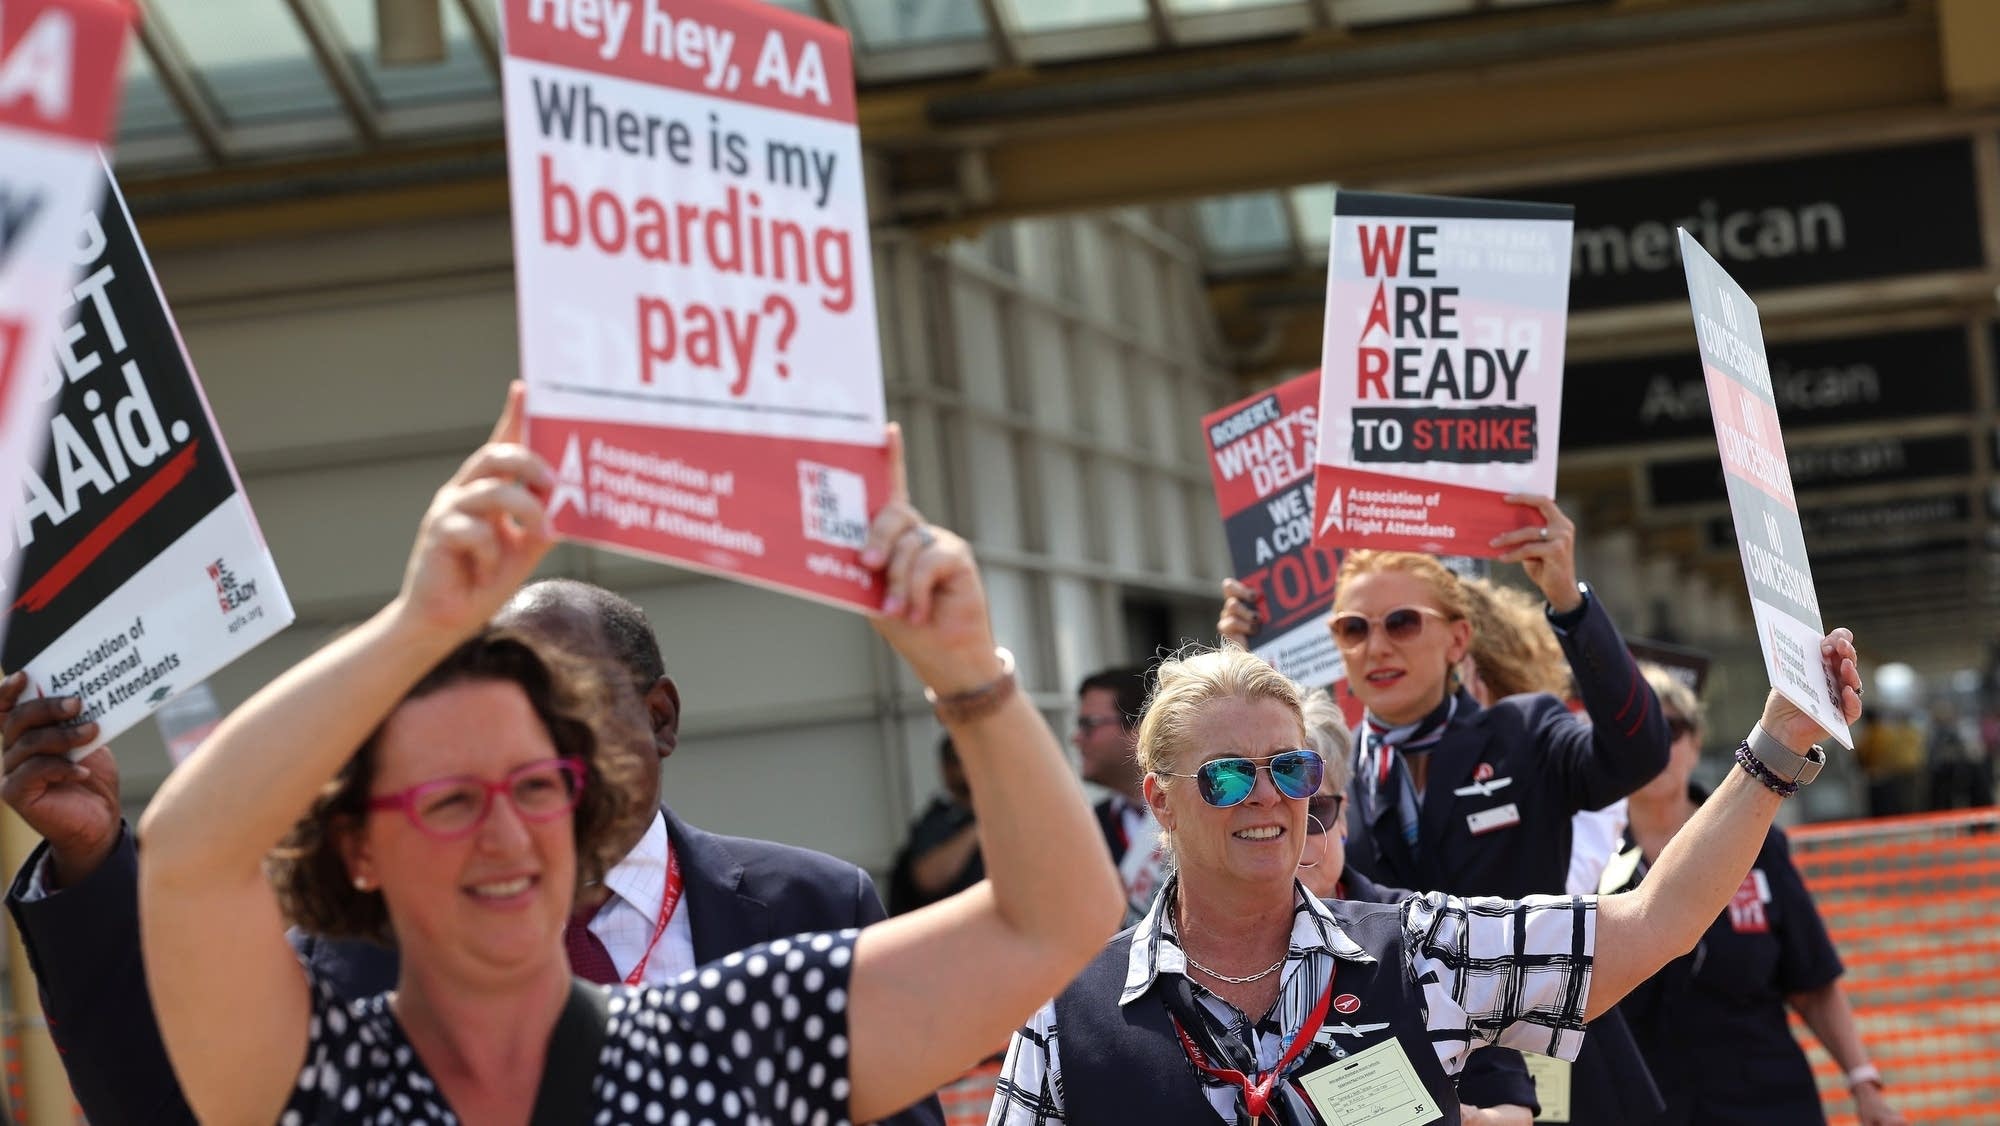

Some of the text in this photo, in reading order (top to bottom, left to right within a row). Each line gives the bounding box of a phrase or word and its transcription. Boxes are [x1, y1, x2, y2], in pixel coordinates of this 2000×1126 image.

[641, 0, 742, 91] hey,
[753, 29, 831, 106] AA
[530, 78, 837, 209] Where is my
[538, 154, 855, 313] boarding
[1357, 224, 1438, 278] WE
[1573, 196, 1845, 279] merican
[1360, 279, 1460, 343] ARE
[1717, 286, 1738, 333] NO
[635, 291, 799, 397] pay?
[1357, 347, 1529, 401] READY
[17, 358, 191, 549] AAid.
[1215, 405, 1317, 481] WHAT'S
[1356, 417, 1533, 451] TO STRIKE
[1266, 488, 1306, 526] WE
[1347, 487, 1441, 507] Association of
[1347, 502, 1428, 521] Professional
[1255, 536, 1275, 566] A
[1345, 517, 1456, 539] Flight Attendants
[1762, 509, 1784, 557] NO
[1745, 539, 1821, 618] CONCESSIONS
[50, 616, 145, 693] Association of
[106, 653, 181, 709] Attendants
